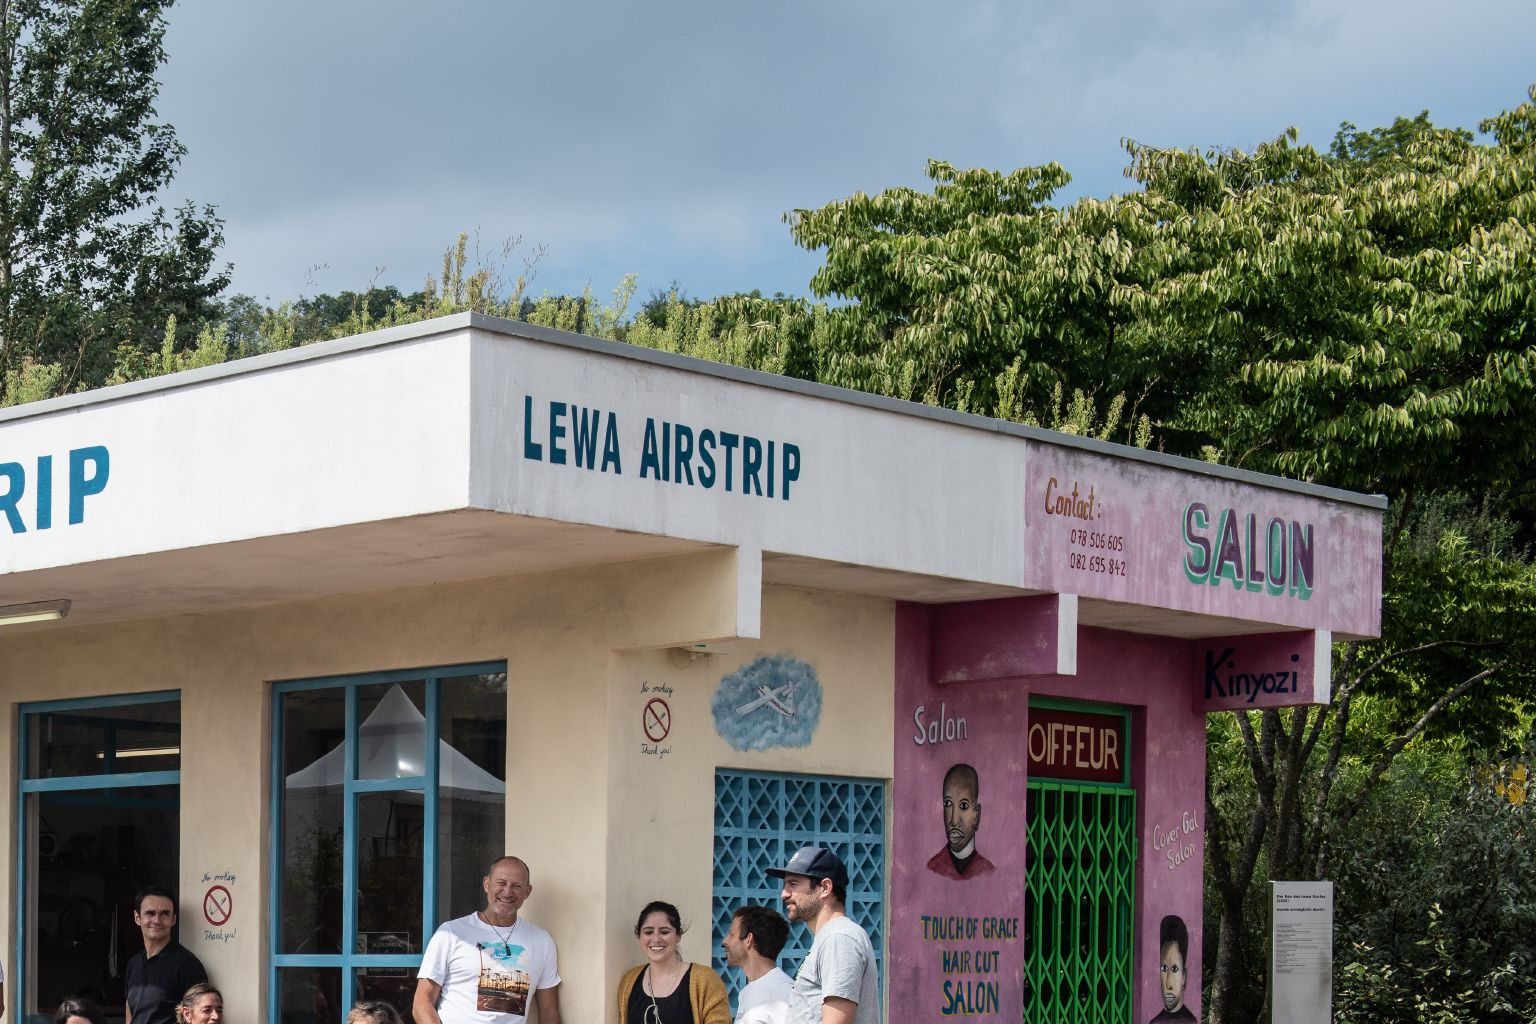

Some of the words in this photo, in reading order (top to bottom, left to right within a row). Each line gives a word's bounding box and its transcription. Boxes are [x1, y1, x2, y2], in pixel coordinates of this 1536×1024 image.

[524, 395, 622, 474] LEWA
[639, 417, 801, 500] AIRSTRIP
[1070, 528, 1087, 547] 078
[1089, 531, 1106, 549] 506
[1107, 534, 1123, 552] 605
[1182, 502, 1314, 601] SALON
[1070, 553, 1086, 570] 082
[1089, 554, 1106, 573] 695
[1108, 557, 1126, 576] 842
[640, 680, 650, 694] No
[1205, 648, 1300, 703] Kinyozi
[913, 702, 968, 745] Salon
[641, 743, 658, 755] Thank
[1028, 722, 1119, 770] OIFFEUR
[1153, 824, 1180, 851] Cover
[1182, 808, 1199, 835] Gal
[1166, 840, 1195, 870] Salon
[201, 871, 211, 882] No
[920, 915, 963, 940] TOUCH
[965, 916, 979, 940] OF
[982, 916, 1019, 940] GRACE
[942, 950, 971, 974] HAIR
[975, 950, 1000, 974] CUT
[941, 980, 1000, 1015] SALON
